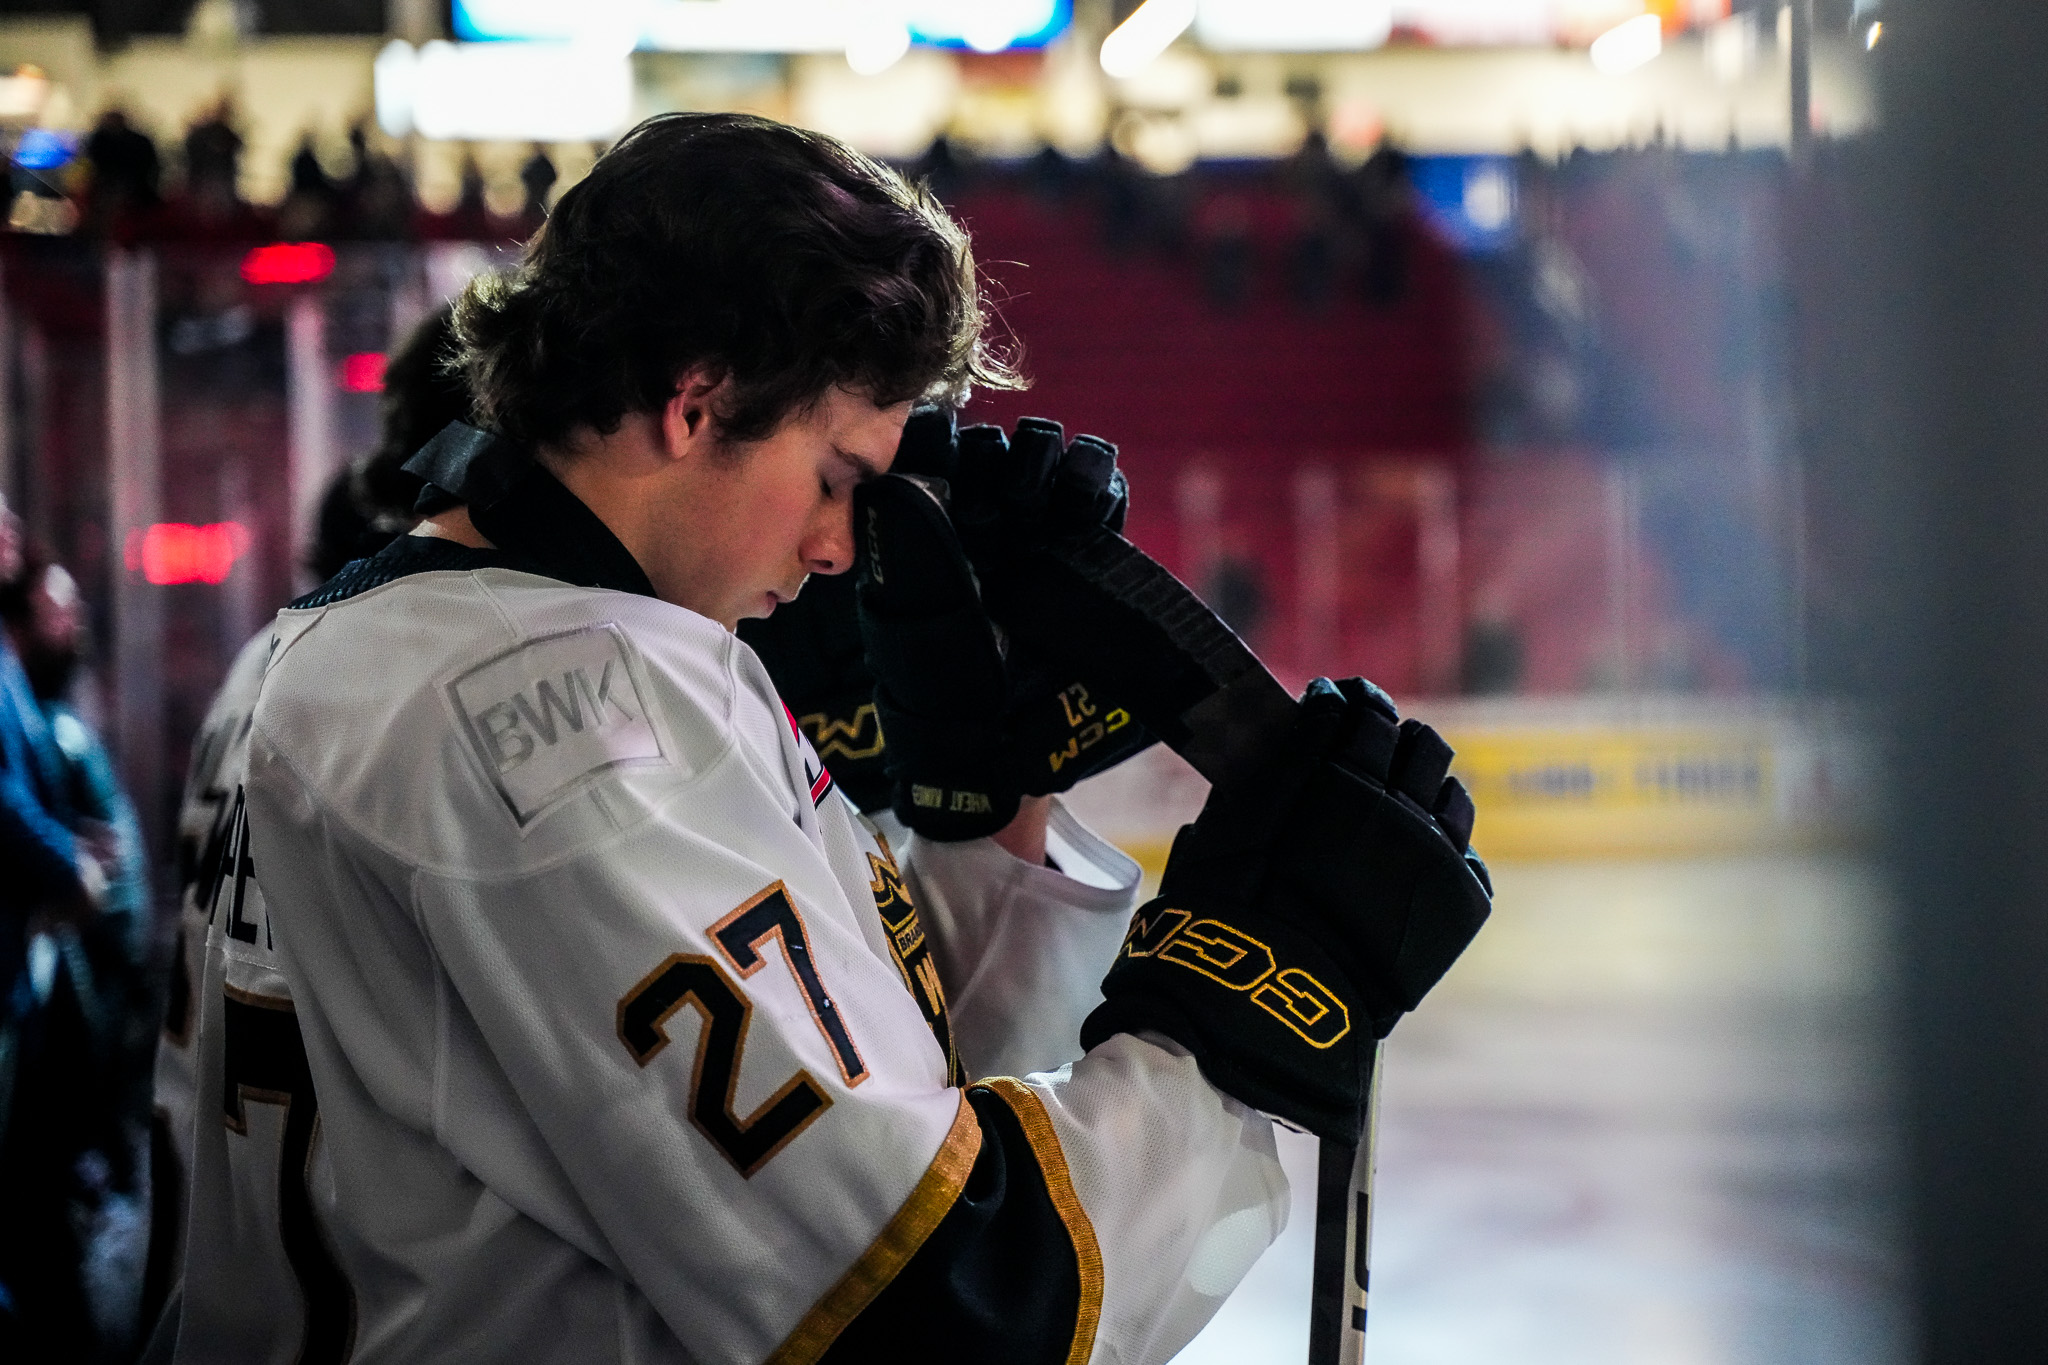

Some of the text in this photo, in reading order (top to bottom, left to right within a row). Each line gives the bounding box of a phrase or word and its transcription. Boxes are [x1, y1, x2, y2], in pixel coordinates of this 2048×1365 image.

[475, 659, 634, 776] BWK
[1048, 707, 1131, 772] CCM
[1055, 681, 1098, 728] 27
[616, 878, 870, 1181] 27
